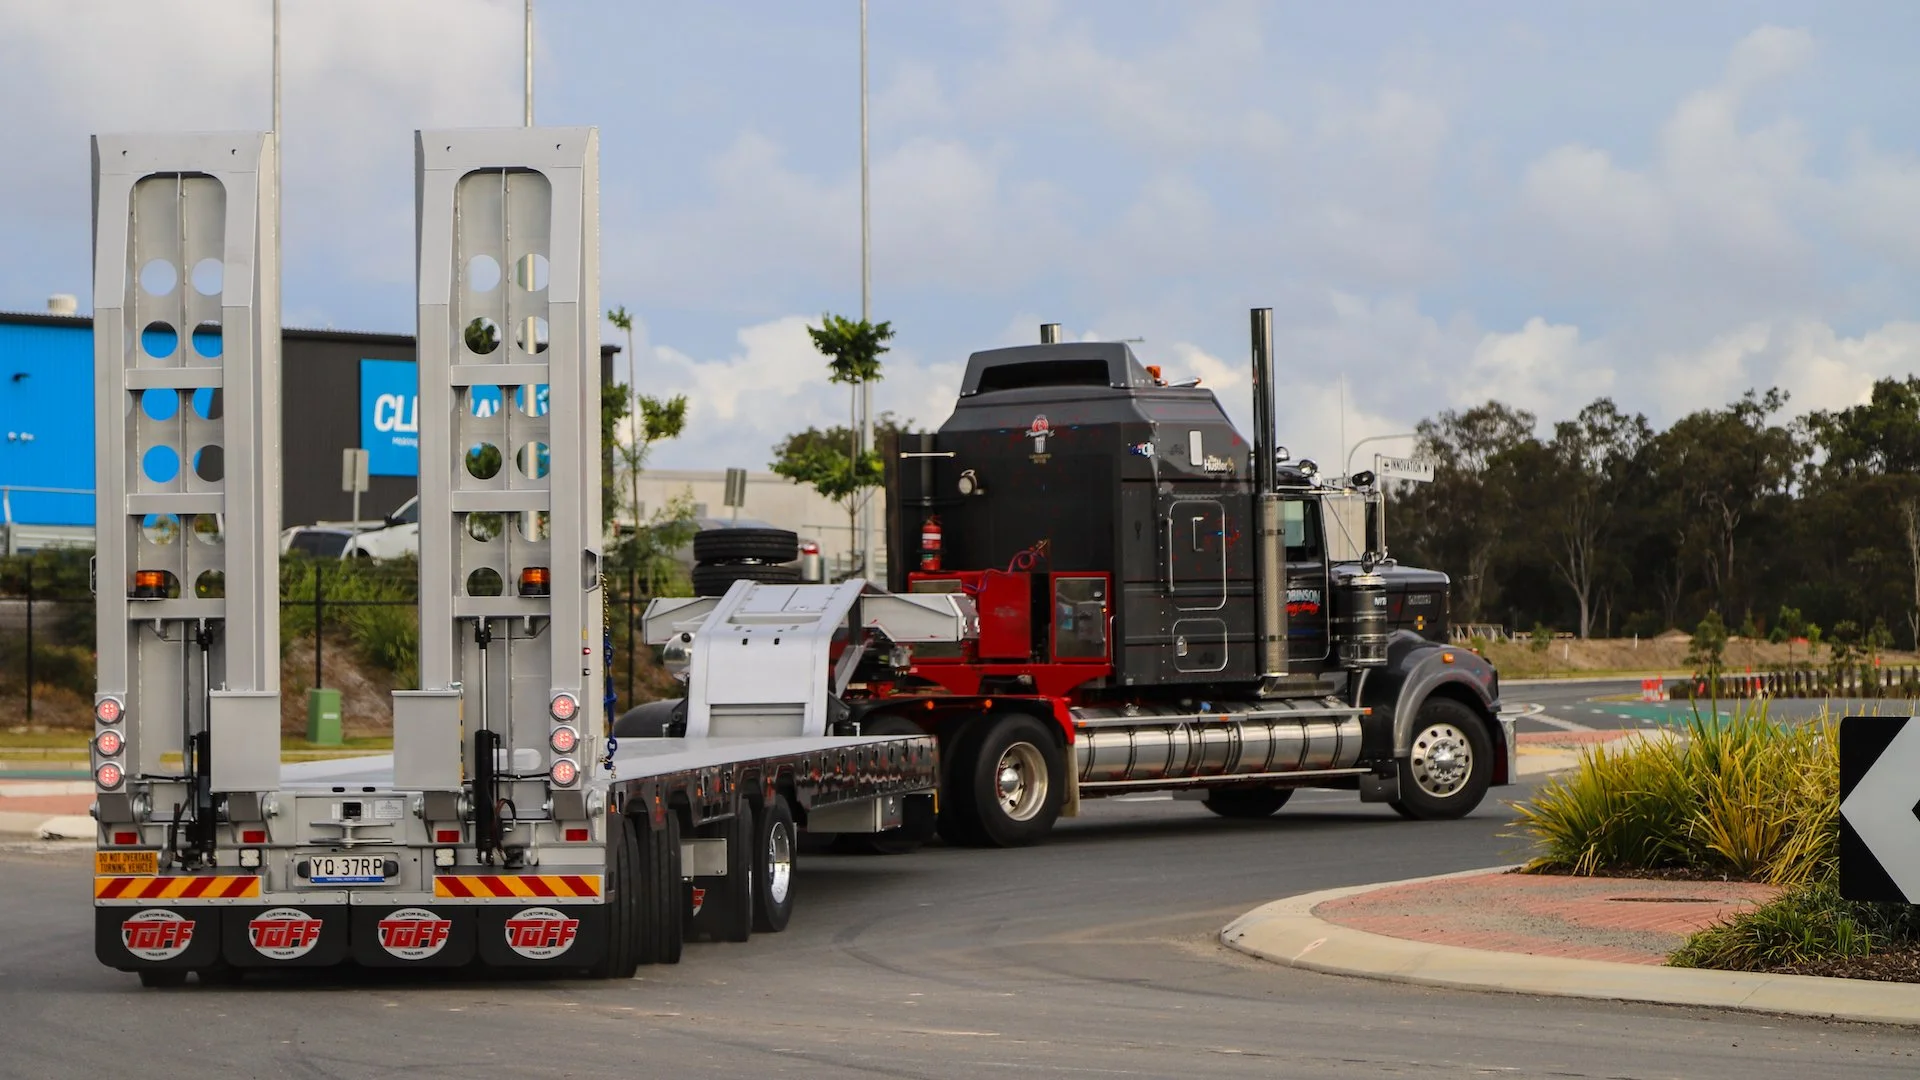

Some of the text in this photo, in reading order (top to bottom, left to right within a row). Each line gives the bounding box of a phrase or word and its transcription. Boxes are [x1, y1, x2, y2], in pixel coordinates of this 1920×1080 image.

[1390, 459, 1422, 473] INNOVATION
[1286, 589, 1321, 604] OBINSON
[99, 852, 153, 862] DO NOT OVERTAKE
[101, 863, 153, 873] TURNING VEHICLE
[313, 859, 382, 876] YQ 37RP
